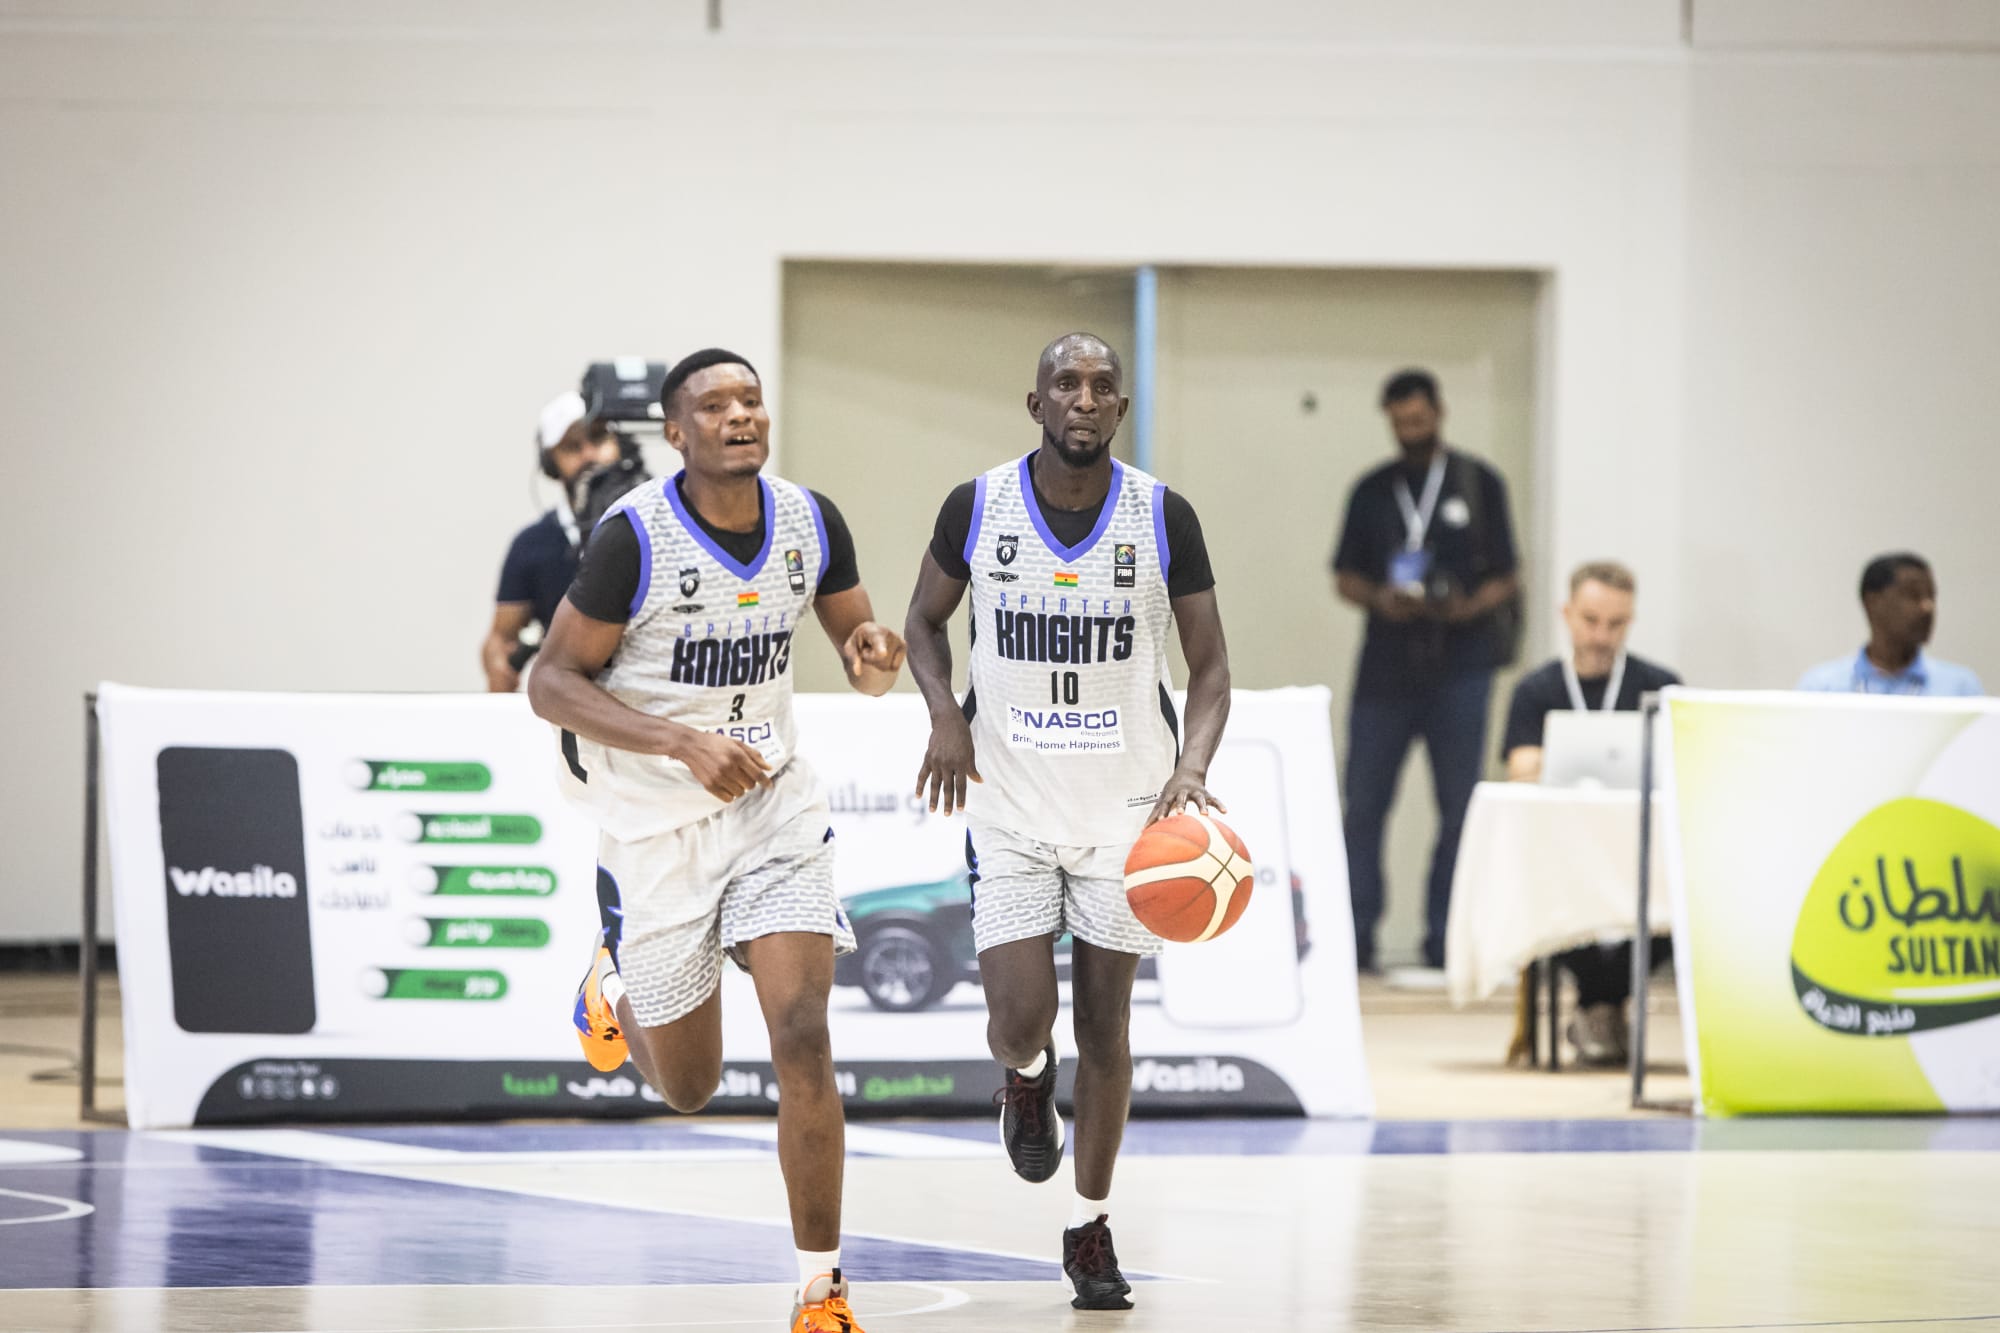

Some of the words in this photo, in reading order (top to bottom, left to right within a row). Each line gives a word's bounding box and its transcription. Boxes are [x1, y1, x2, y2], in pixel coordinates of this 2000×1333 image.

[1117, 568, 1133, 577] FIBA
[684, 612, 787, 639] SPINTE
[995, 608, 1136, 664] KNIGHTS
[670, 631, 794, 688] KNIGHTS
[1051, 670, 1079, 706] 10
[728, 693, 746, 723] 3
[1024, 709, 1118, 730] NASCO
[1012, 733, 1033, 743] Brin
[1035, 740, 1066, 750] Home
[1069, 740, 1120, 751] Happiness
[169, 864, 298, 898] Wasila
[1887, 936, 2000, 976] SULTAN
